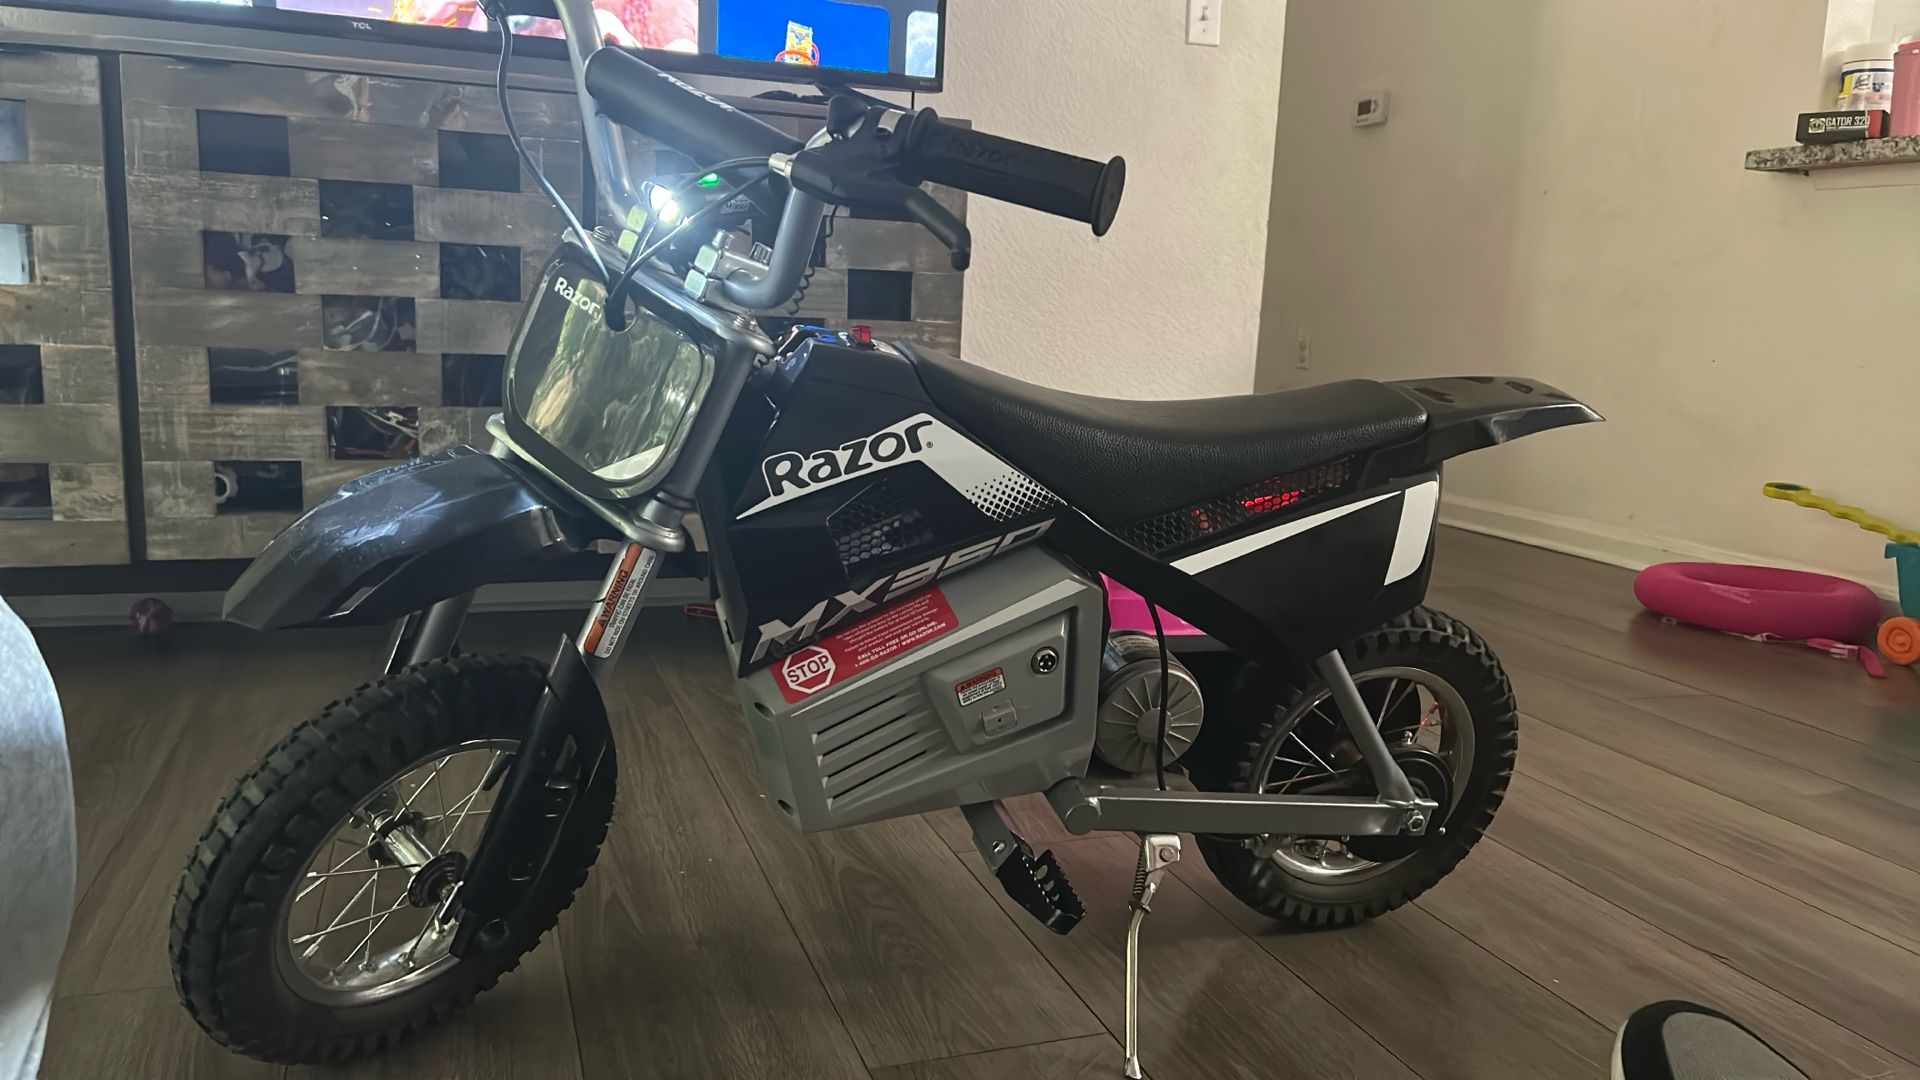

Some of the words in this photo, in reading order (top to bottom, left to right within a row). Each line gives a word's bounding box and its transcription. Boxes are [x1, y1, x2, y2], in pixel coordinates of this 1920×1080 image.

[351, 21, 372, 30] TCL
[1825, 117, 1852, 127] GATOR
[554, 276, 601, 315] Razor
[764, 420, 934, 497] Razor
[601, 569, 628, 618] WARNING
[750, 517, 1056, 664] MX350
[786, 654, 830, 684] STOP
